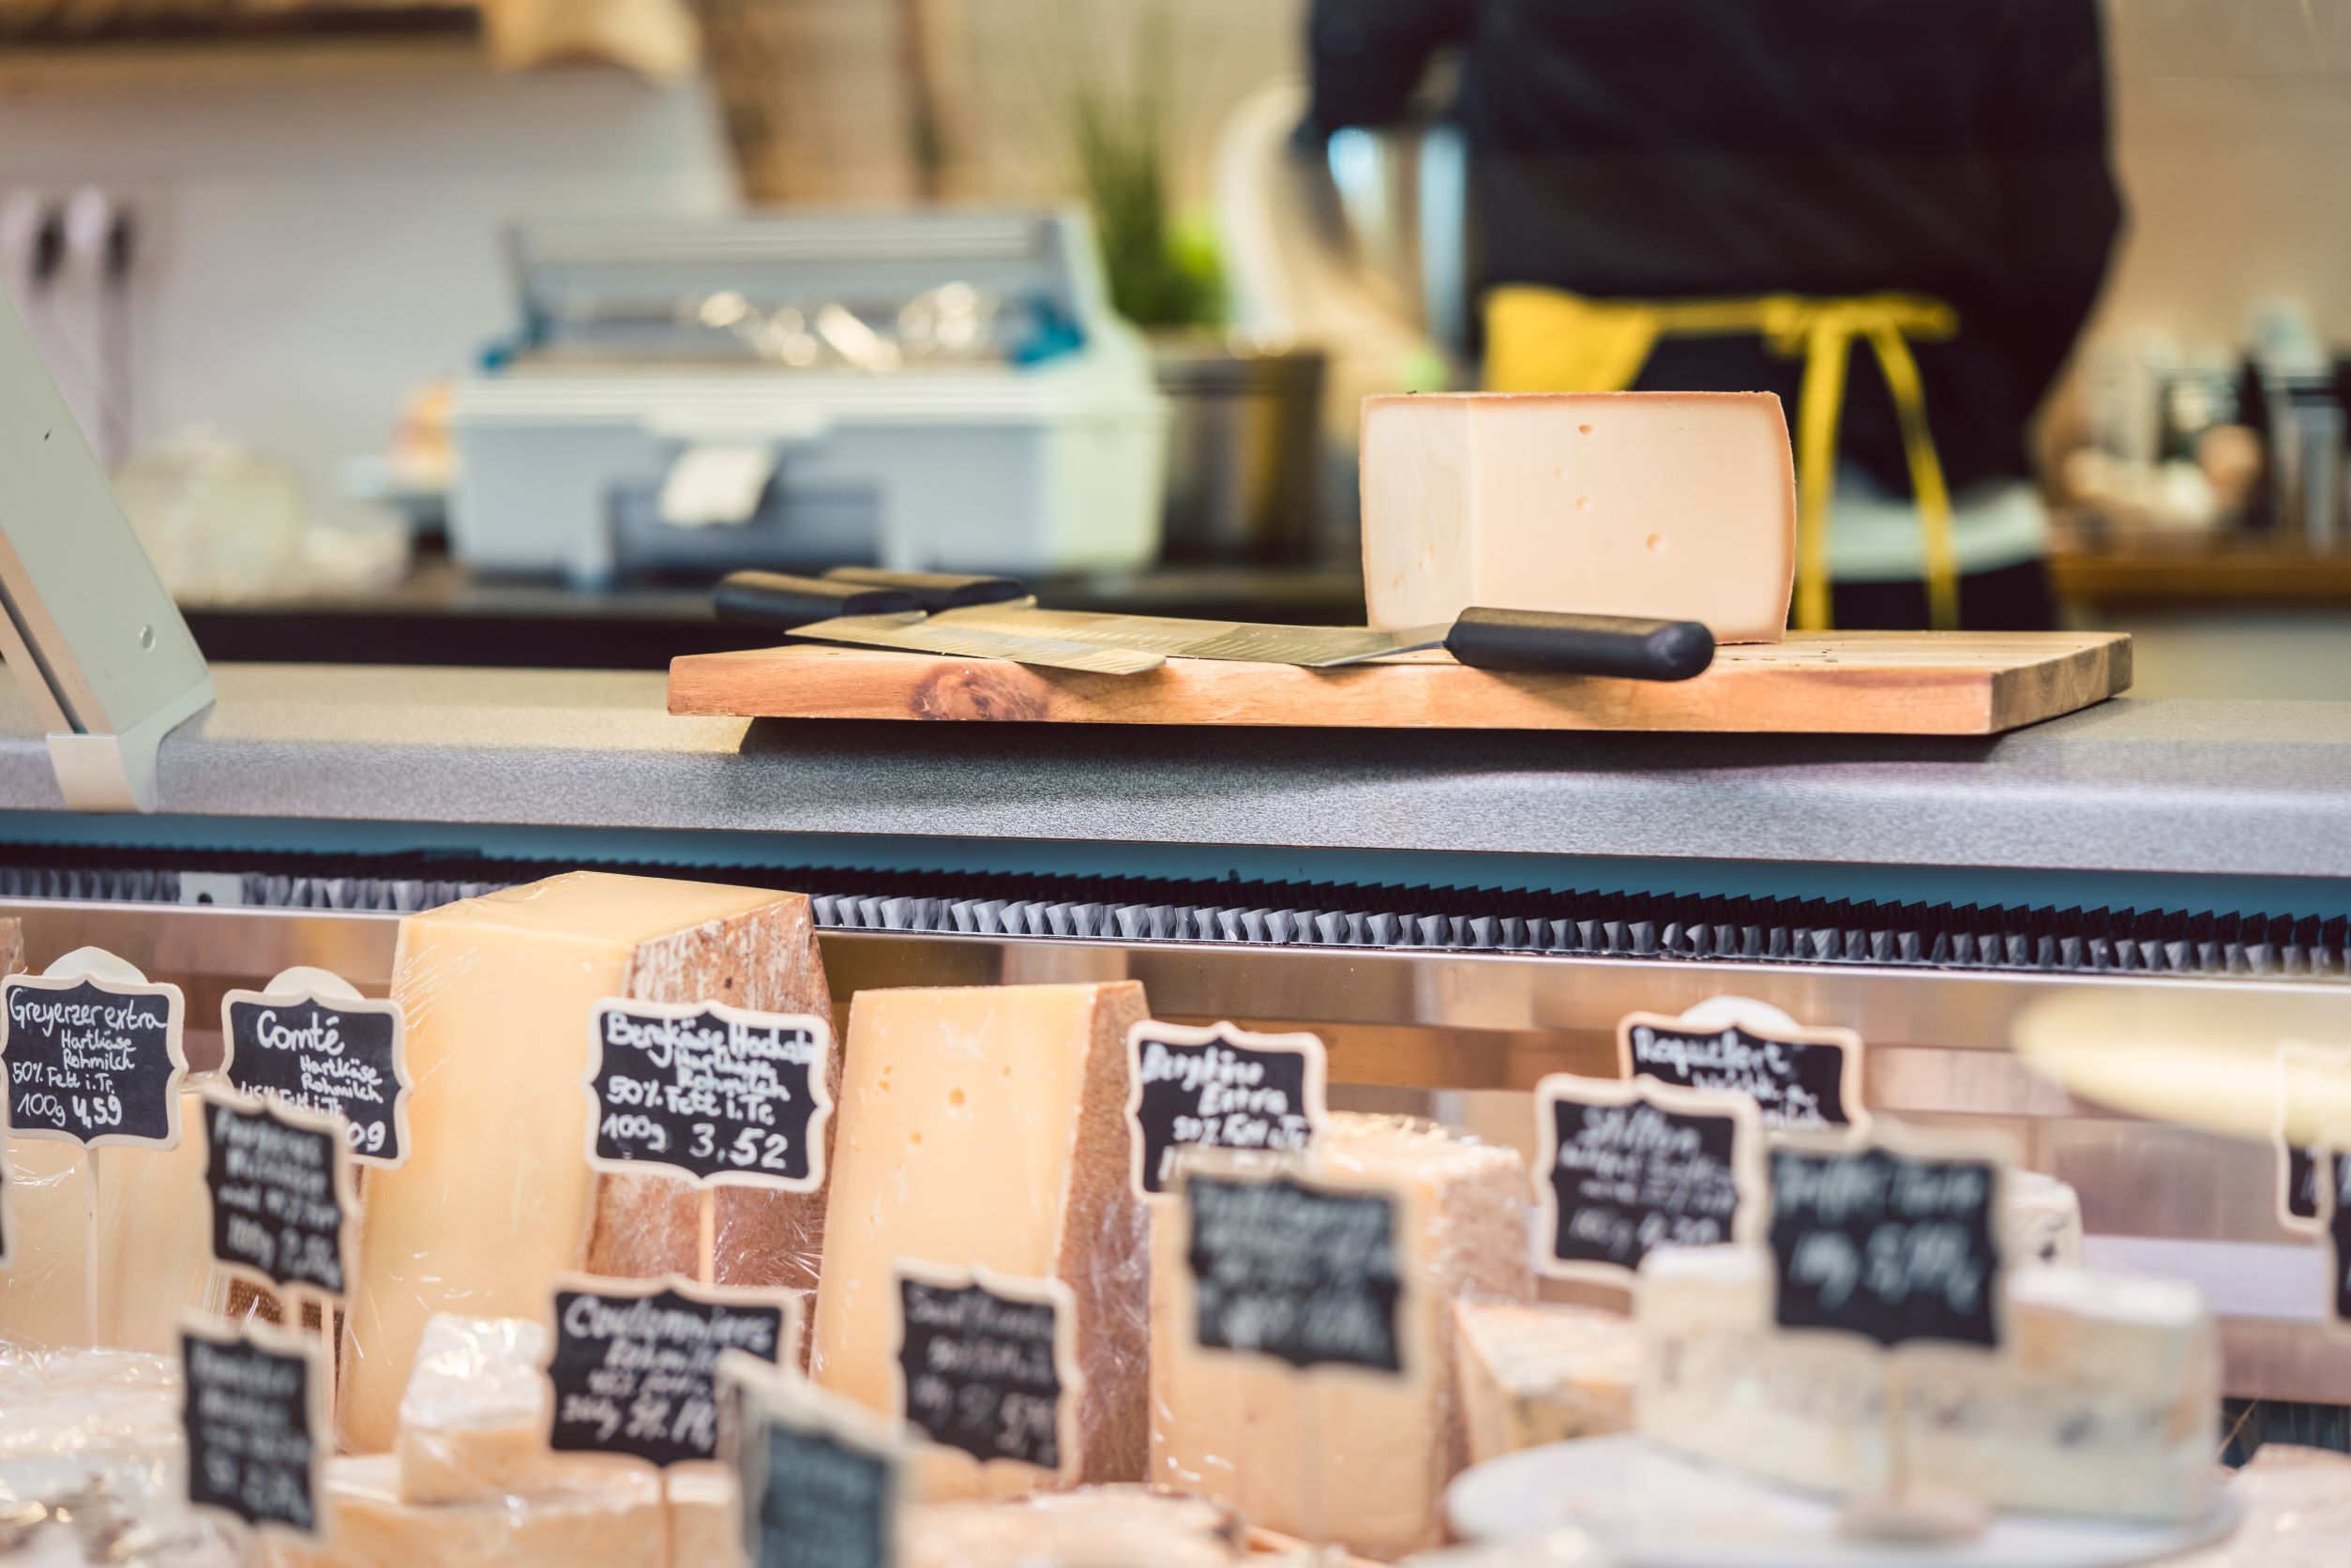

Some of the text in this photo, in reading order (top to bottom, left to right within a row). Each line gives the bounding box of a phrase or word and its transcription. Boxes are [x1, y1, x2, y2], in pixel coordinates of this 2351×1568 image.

[9, 988, 168, 1037] Greyerzer extra
[61, 1029, 137, 1052] Hartkäse
[257, 1010, 345, 1055] Comté
[606, 1010, 726, 1068] Bergkäse
[63, 1048, 136, 1071] Rohmilch
[299, 1054, 384, 1085] Hartkäse
[47, 1066, 81, 1089] Fett
[301, 1073, 384, 1104] Rohmilch
[17, 1093, 123, 1129] 100g 4,59
[664, 1084, 721, 1117] Fett
[600, 1113, 789, 1169] 100g 3,52
